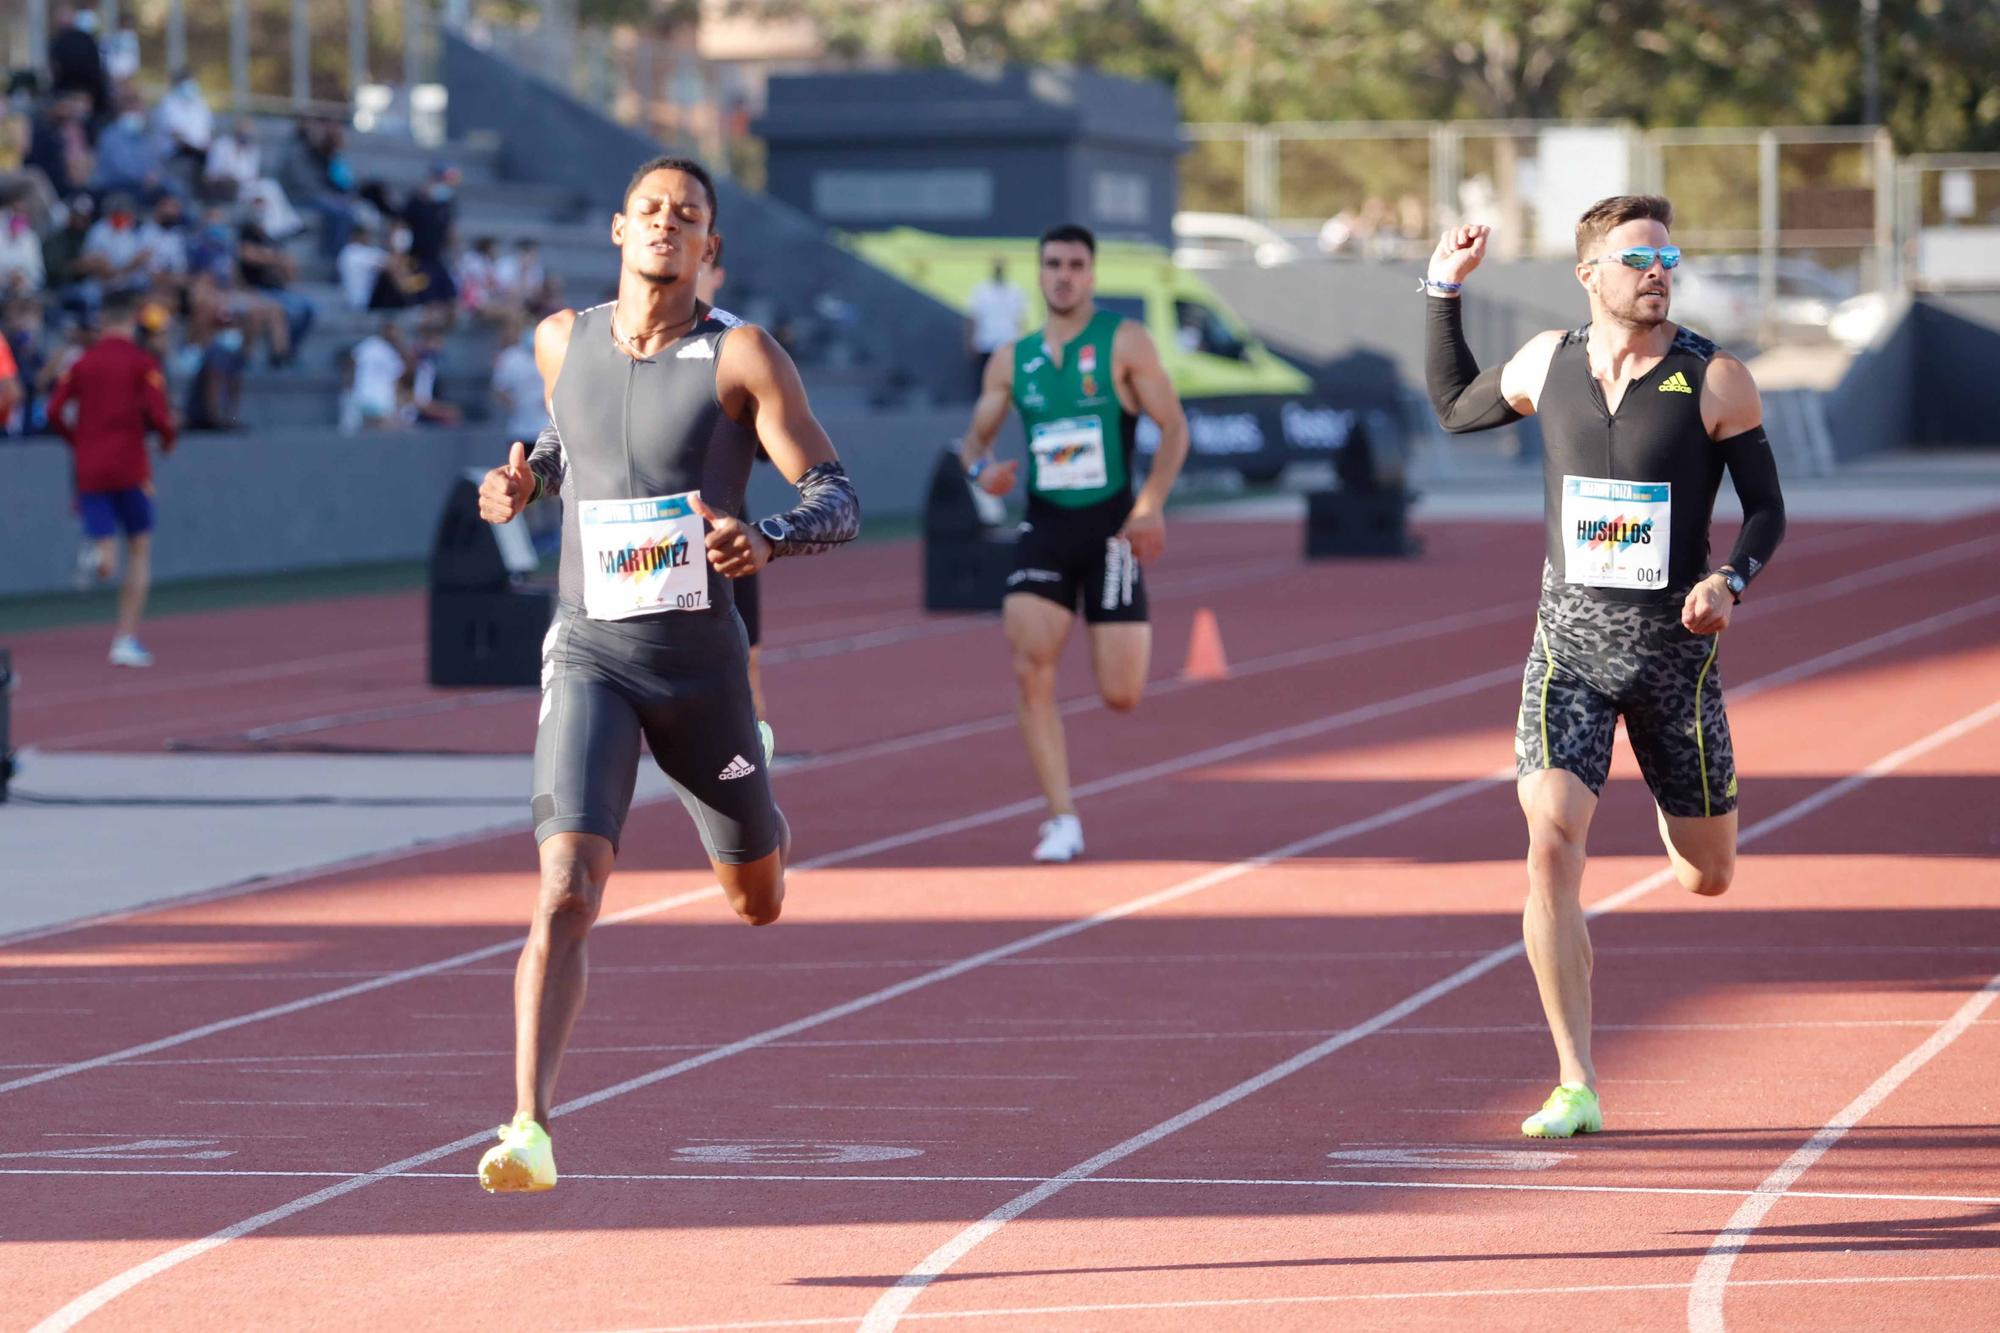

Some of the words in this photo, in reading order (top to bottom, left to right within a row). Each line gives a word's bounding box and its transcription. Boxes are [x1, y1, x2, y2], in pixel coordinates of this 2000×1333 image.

[1658, 384, 1693, 394] adidas
[1577, 520, 1651, 544] HUSILLOS
[598, 541, 690, 573] MARTINEZ
[1637, 567, 1662, 582] 001
[676, 591, 702, 608] 007
[718, 764, 756, 780] adidas
